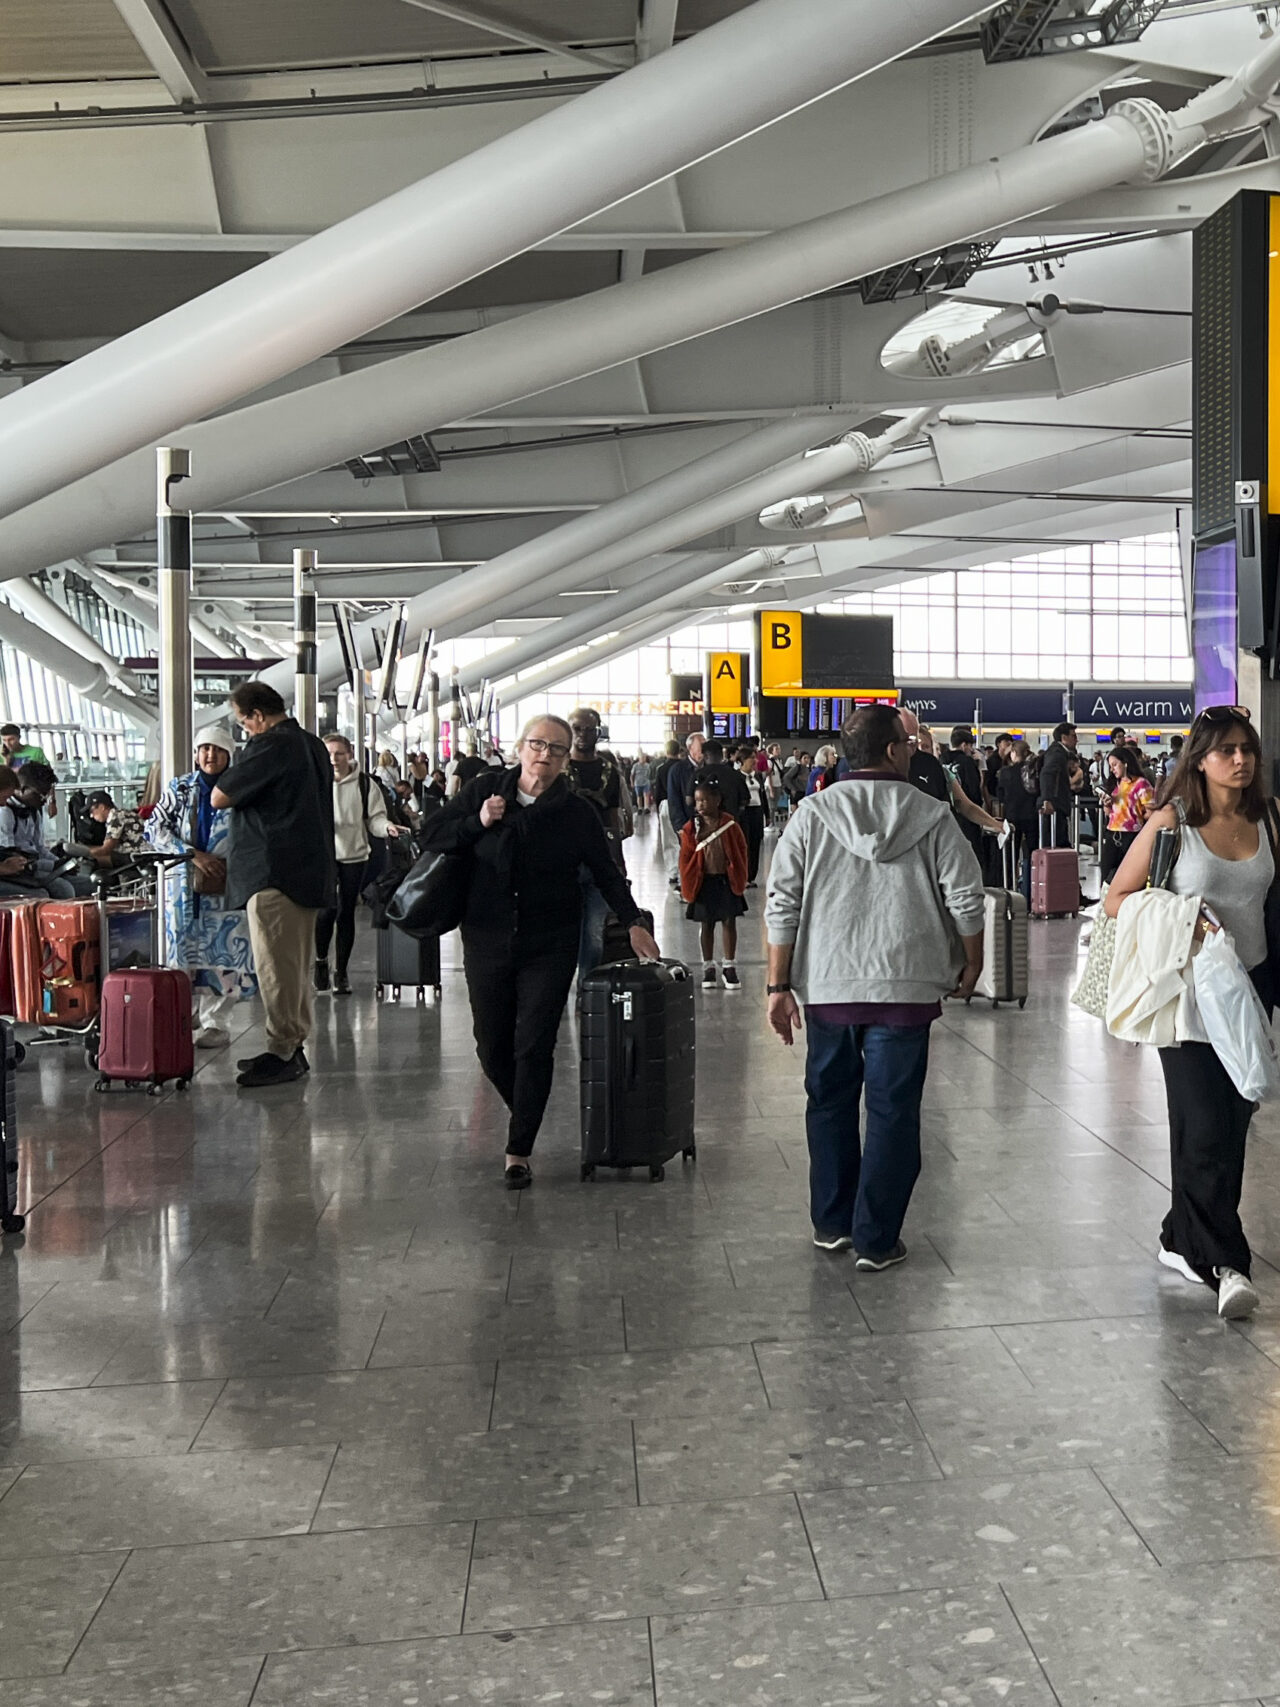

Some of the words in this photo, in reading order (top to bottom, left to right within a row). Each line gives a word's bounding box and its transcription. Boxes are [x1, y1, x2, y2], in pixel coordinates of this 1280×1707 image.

[771, 622, 792, 650] B
[715, 660, 736, 680] A
[1090, 696, 1109, 716] A
[1115, 701, 1173, 716] warm
